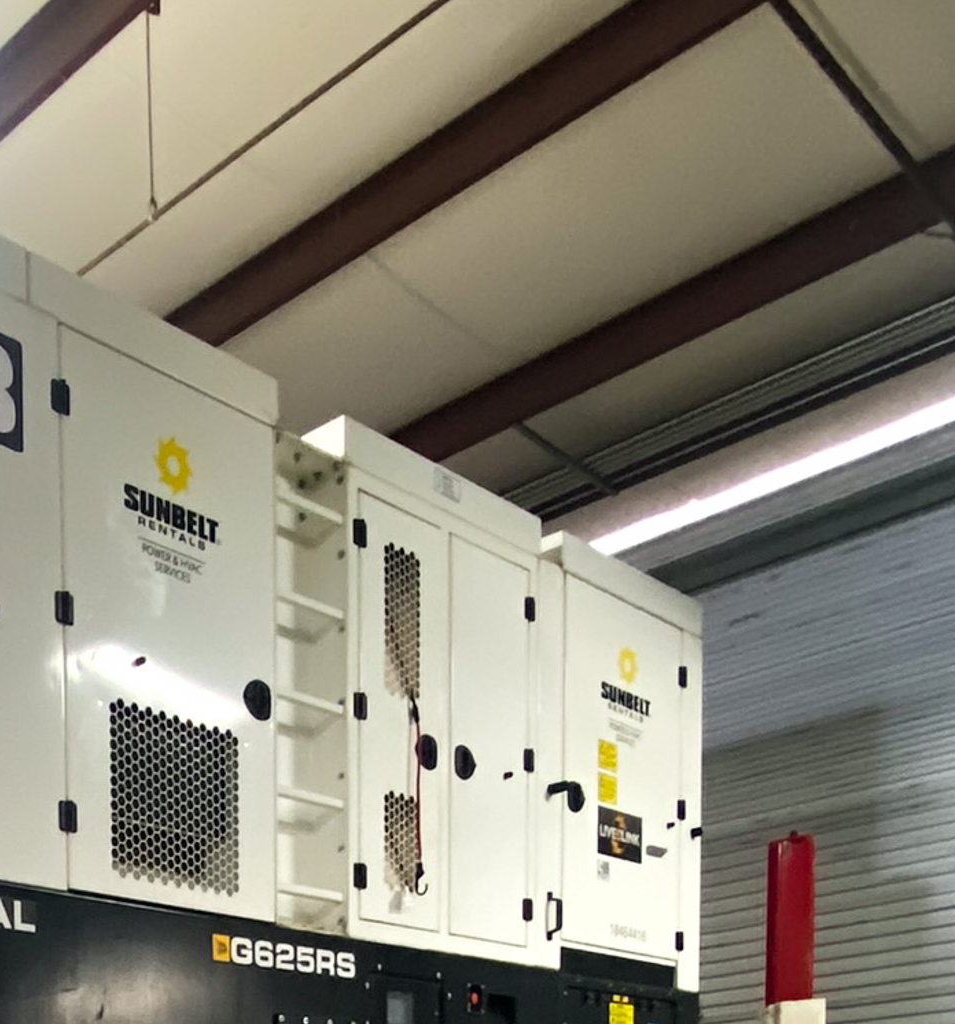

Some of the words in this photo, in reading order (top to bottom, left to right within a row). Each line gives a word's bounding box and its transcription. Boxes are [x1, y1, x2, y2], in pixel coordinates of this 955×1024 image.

[123, 483, 220, 544] SUNBELT
[137, 515, 206, 552] RENTALS
[141, 542, 172, 563] POWER
[600, 680, 651, 717] SUNBELT
[230, 936, 356, 979] G625RS
